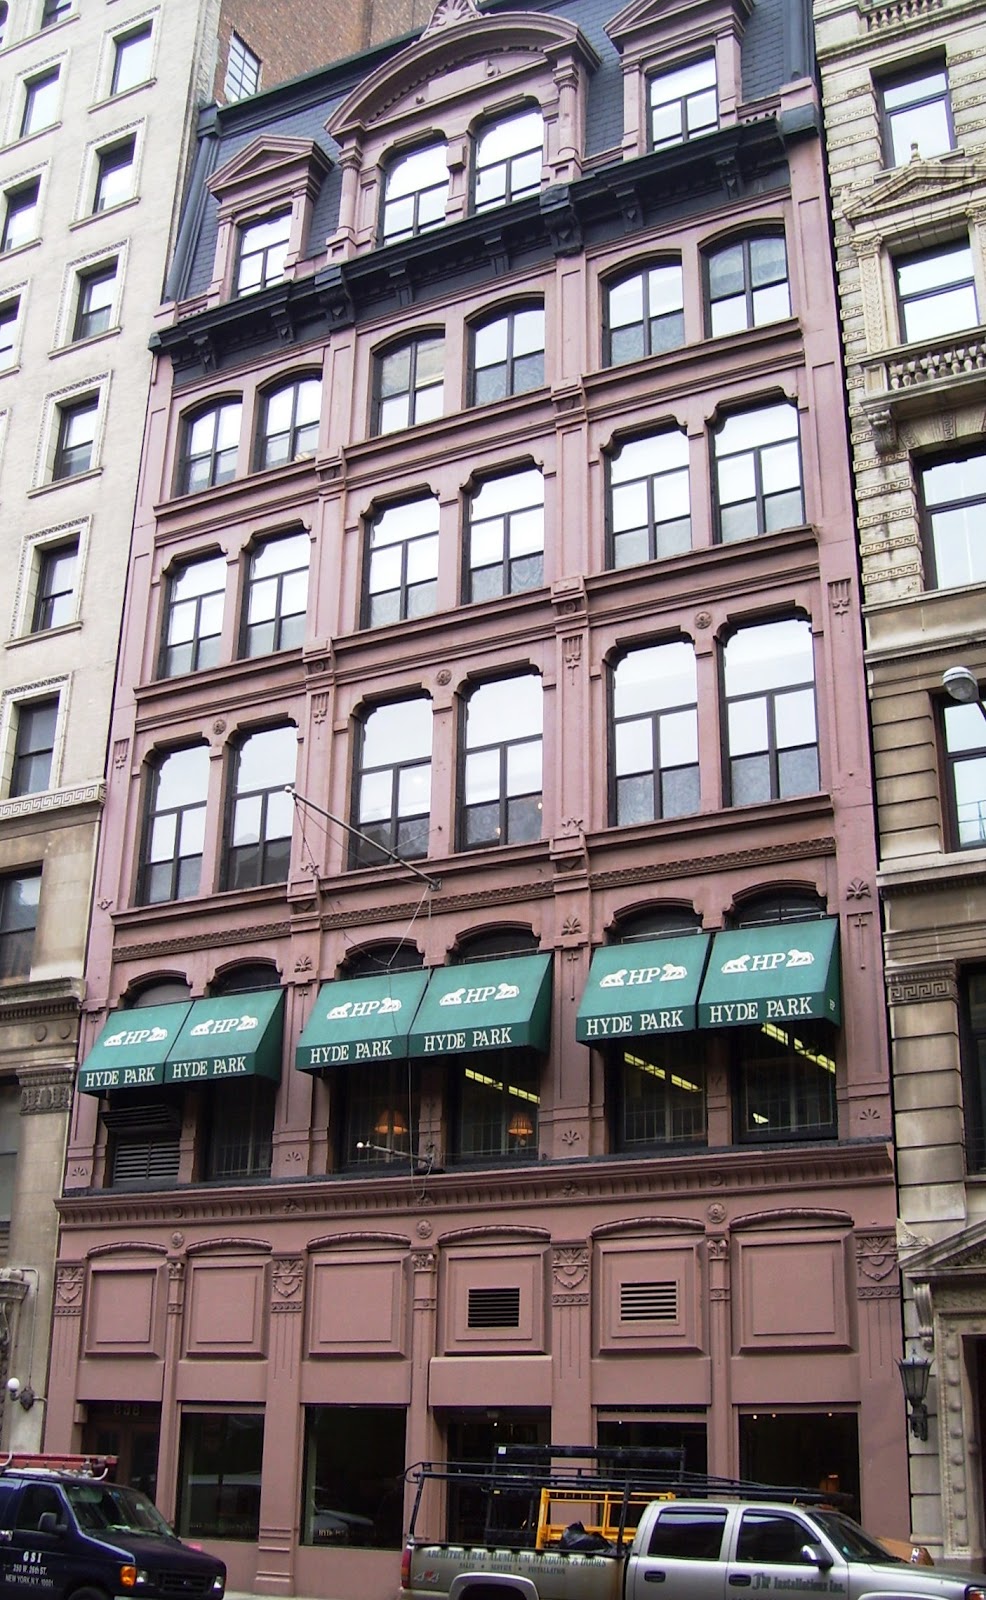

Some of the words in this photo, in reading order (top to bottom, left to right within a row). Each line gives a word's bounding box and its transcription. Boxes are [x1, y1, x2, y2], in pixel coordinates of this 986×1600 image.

[750, 952, 786, 971] HP
[626, 967, 661, 986] HP
[464, 987, 496, 1004] HP
[349, 1001, 380, 1017] HP
[709, 1002, 759, 1023] HYDE
[766, 997, 813, 1018] PARK
[211, 1018, 239, 1034] HP
[586, 1015, 633, 1036] HYDE
[640, 1010, 684, 1031] PARK
[123, 1030, 150, 1045] HP
[423, 1033, 466, 1052] HYDE
[472, 1027, 512, 1047] PARK
[310, 1045, 349, 1064] HYDE
[355, 1040, 392, 1059] PARK
[85, 1070, 119, 1088] HYDE
[124, 1067, 156, 1083] PARK
[172, 1061, 208, 1079] HYDE
[213, 1056, 247, 1075] PARK
